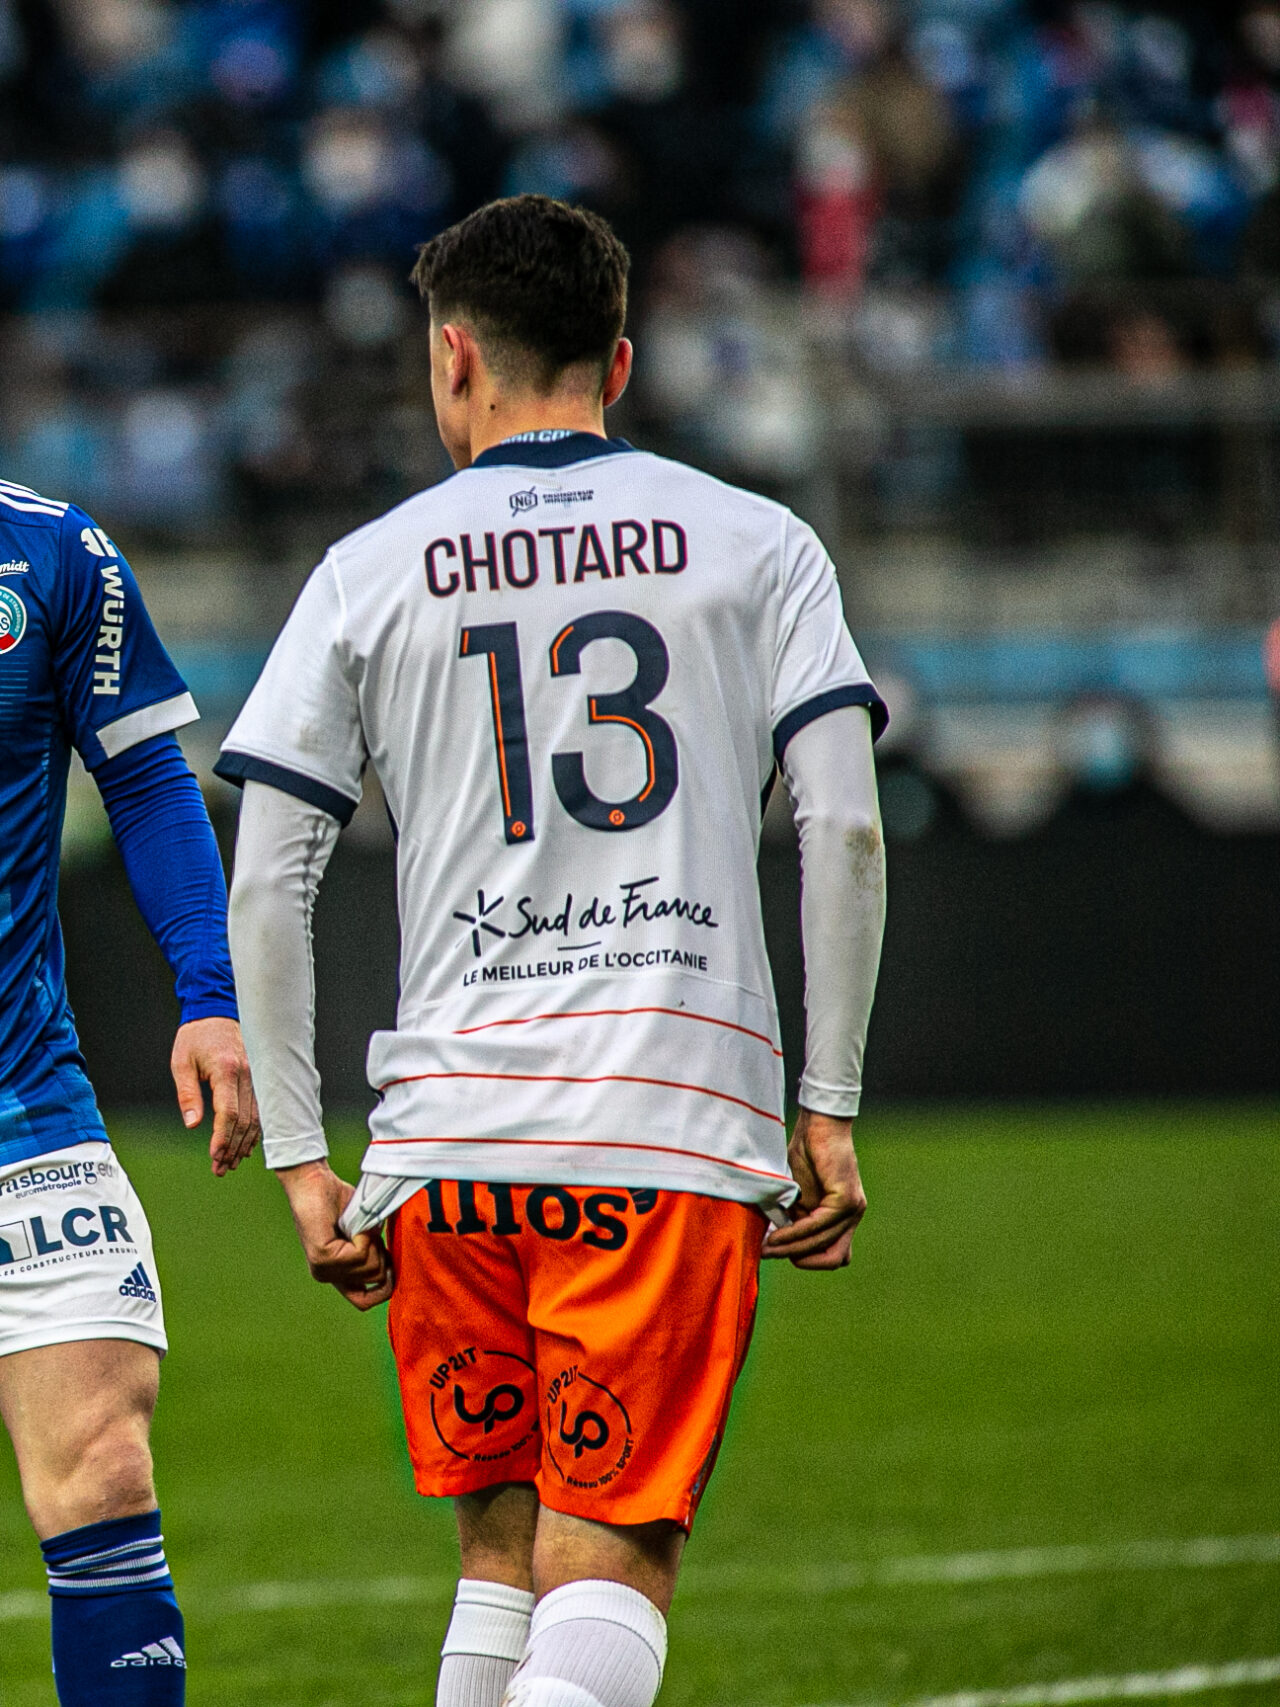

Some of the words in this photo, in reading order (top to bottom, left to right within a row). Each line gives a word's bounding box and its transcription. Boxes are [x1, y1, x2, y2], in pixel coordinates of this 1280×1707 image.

[424, 518, 689, 598] CHOTARD
[93, 564, 125, 695] WÜRTH
[459, 609, 679, 845] 13
[508, 893, 573, 938] Sud
[578, 896, 616, 930] de
[619, 876, 719, 929] France
[462, 969, 478, 987] LE
[482, 960, 574, 982] MEILLEUR
[578, 954, 599, 971] DE
[604, 949, 708, 972] L'OCCITANIE
[29, 1205, 135, 1257] LCR
[119, 1283, 157, 1303] adidas
[429, 1346, 477, 1390] UP2IT
[547, 1364, 579, 1404] UP2IT
